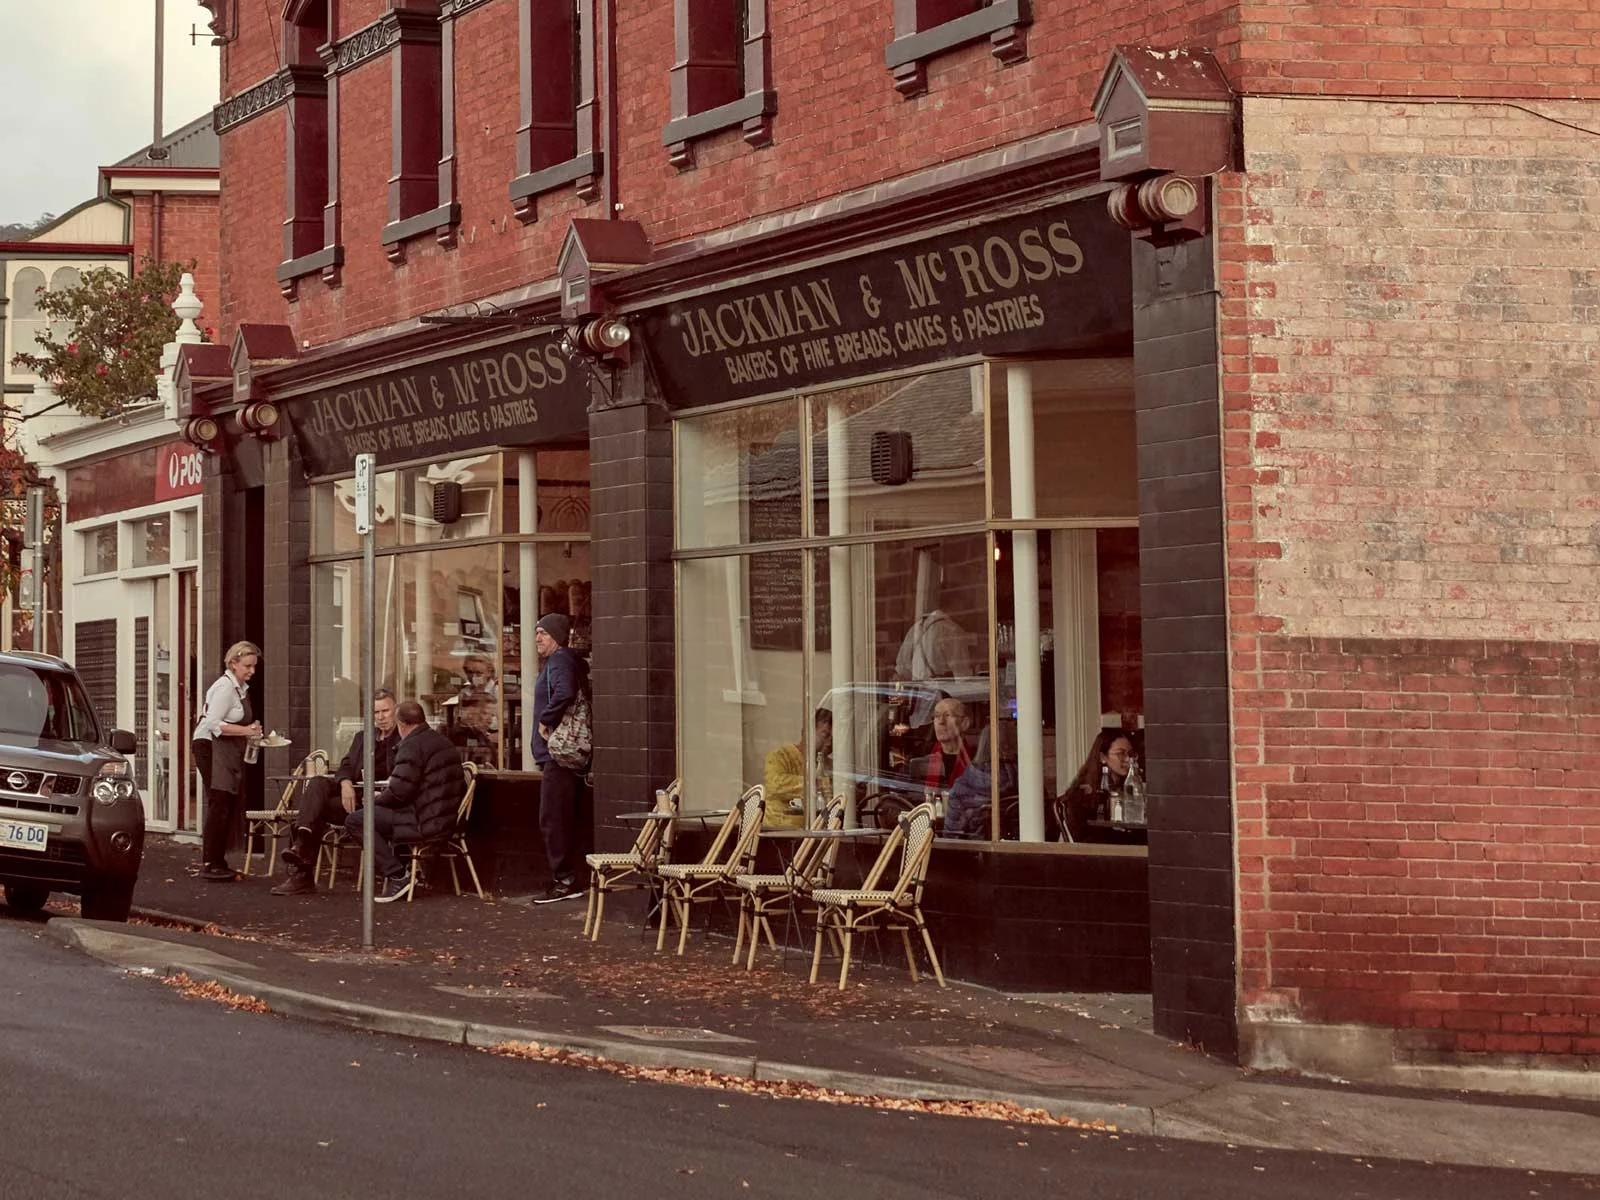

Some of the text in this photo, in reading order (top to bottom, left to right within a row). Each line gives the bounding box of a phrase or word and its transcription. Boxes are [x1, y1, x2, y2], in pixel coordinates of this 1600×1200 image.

[681, 278, 841, 357] JACKMAN
[859, 274, 881, 318] &
[725, 294, 1045, 384] BAKERS OF FINE BREADS, CAKES & PASTRIES
[312, 375, 423, 437] JACKMAN
[430, 375, 445, 410] &
[344, 398, 538, 457] BAKERS OF FINE BREADS, CAKES & PASTRIES
[8, 825, 23, 841] 76
